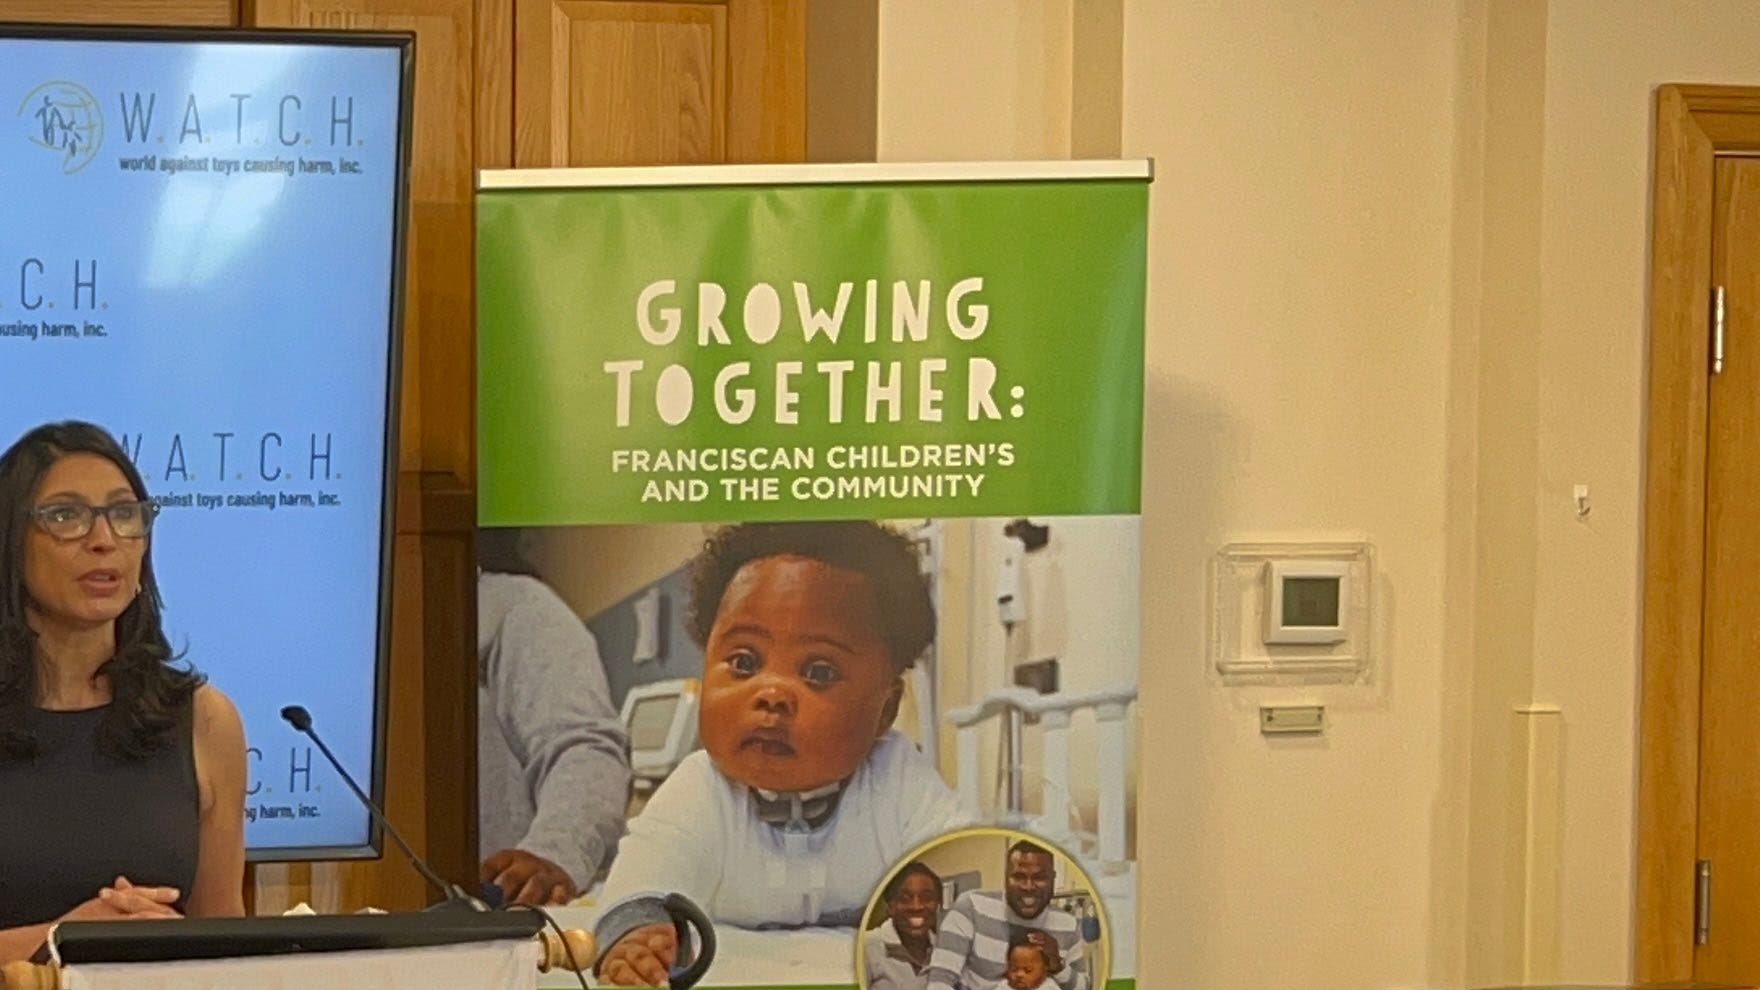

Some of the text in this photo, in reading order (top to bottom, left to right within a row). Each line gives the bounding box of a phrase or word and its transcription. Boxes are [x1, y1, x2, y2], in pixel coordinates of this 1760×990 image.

[119, 156, 156, 171] world
[160, 157, 209, 174] against
[213, 158, 239, 175] toys
[243, 157, 295, 176] causing
[638, 277, 990, 345] GROWING
[604, 357, 1024, 427] TOGETHER:
[613, 443, 1015, 473] FRANCISCAN CHILDREN'S
[197, 493, 223, 510] toys
[227, 491, 276, 510] causing
[641, 473, 985, 503] AND THE COMMUNITY
